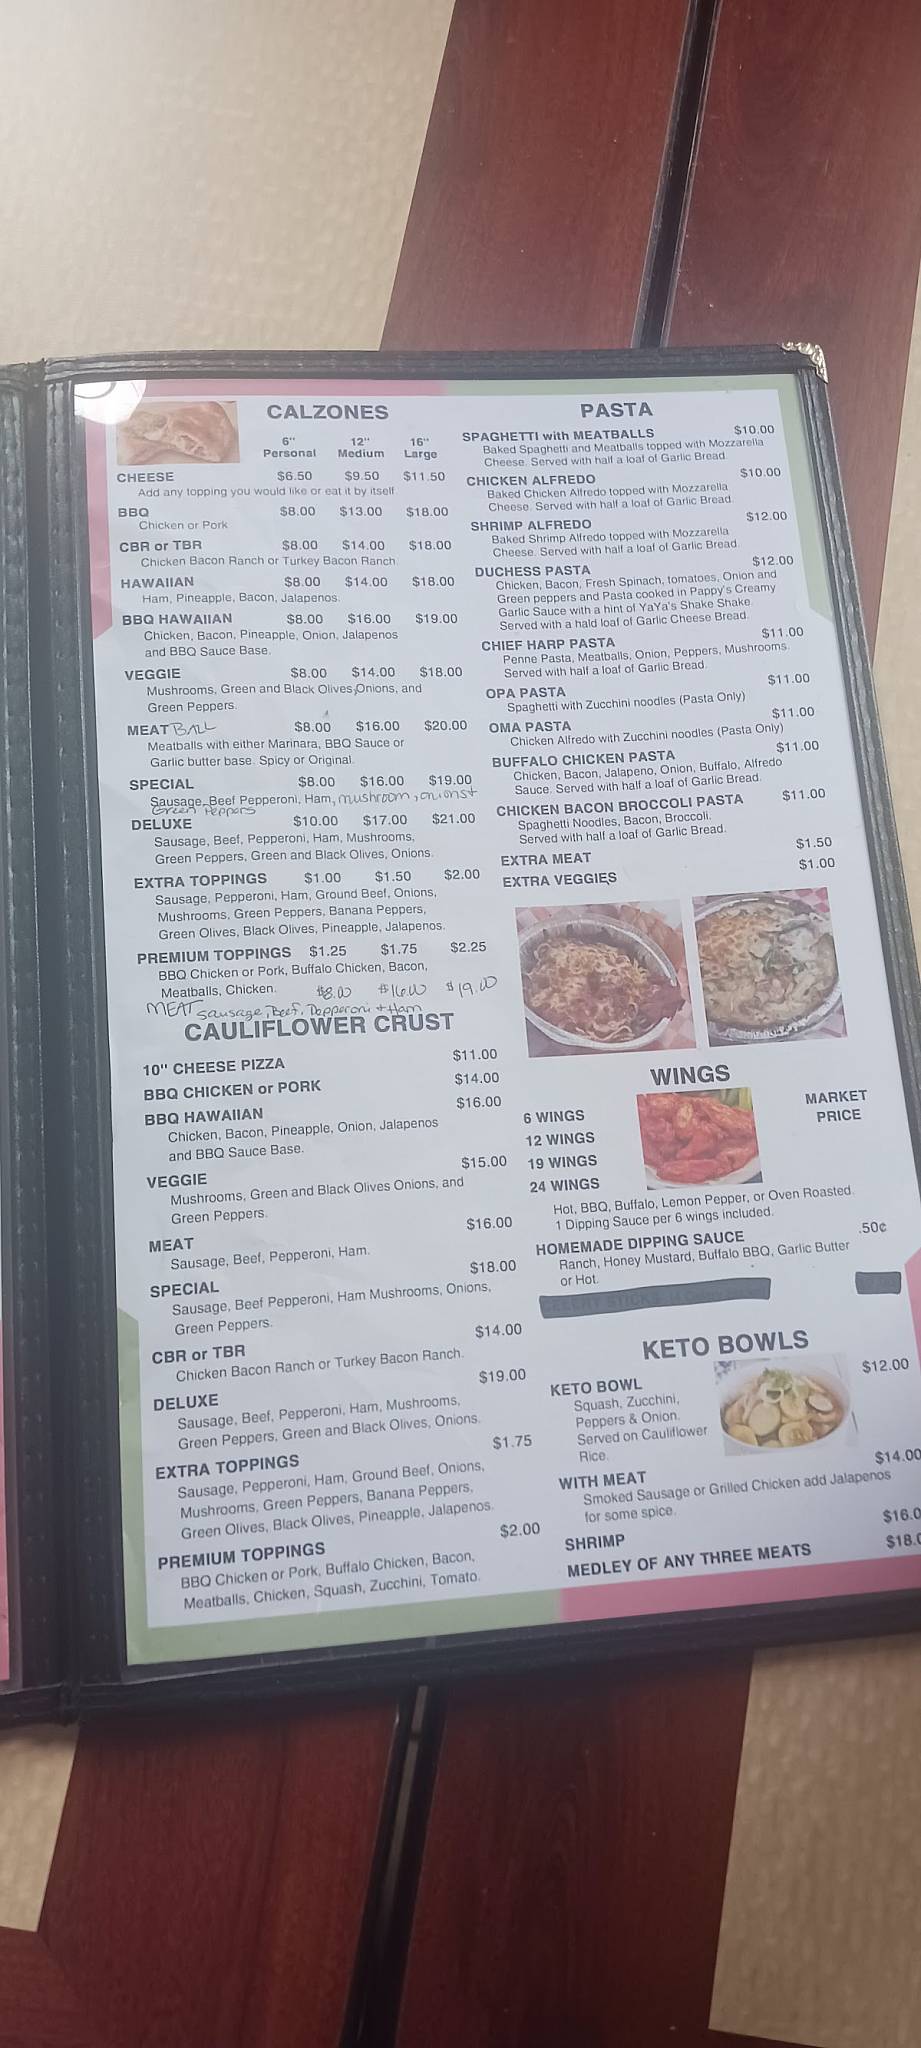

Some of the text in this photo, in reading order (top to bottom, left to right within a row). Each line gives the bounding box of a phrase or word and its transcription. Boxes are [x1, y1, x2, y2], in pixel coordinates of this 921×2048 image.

[266, 404, 388, 420] CALZONES
[580, 401, 653, 418] PASTA
[462, 428, 654, 442] SPAGHETTI with MEATBALLS
[734, 424, 774, 435] $10.00
[263, 448, 437, 460] Personal Medium Large
[116, 470, 445, 483] CHEESE $6.50 $9.50 $11.50
[466, 473, 595, 486] CHICKEN ALFREDO
[740, 467, 780, 478] $10.00
[117, 505, 448, 518] BBQ $8.00 $13.00 $18.00
[138, 520, 227, 530] Chicken or Pork
[119, 539, 452, 552] CBR or TBR $8.00 $14.00 $18.00
[752, 555, 793, 567] $12.00
[475, 564, 591, 577] DUCHESS PASTA
[495, 569, 777, 591] Chicken, Bacon, Fresh Spinach, tomatoes, Onion and
[767, 672, 810, 686] $11.00
[486, 686, 566, 699] OPA PASTA
[147, 701, 237, 713] Green Peppers.
[507, 690, 745, 714] Spaghetti with Zucchini noodles (Pasta Only)
[127, 719, 467, 736] MEAT $8.00 $16.00 $20.00
[776, 740, 819, 754] $11.00
[492, 749, 675, 767] BUFFALO CHICKEN PASTA
[129, 774, 472, 790] SPECIAL $8.00 $16.00 $19.00
[782, 788, 825, 801] $11.00
[496, 793, 743, 816] CHICKEN BACON BROCCOLI PASTA
[154, 831, 415, 849] Sausage, Beef, Pepperoni, Ham, Mushrooms,
[796, 836, 832, 850] $1.50
[500, 851, 591, 866] EXTRA MEAT
[137, 941, 486, 964] PREMIUM TOPPINGS $1.25 $1.75 $2.25
[161, 983, 276, 998] Meatballs, Chicken.
[184, 1009, 454, 1041] CAULIFLOWER CRUST
[452, 1048, 497, 1062] $11.00
[172, 1060, 236, 1075] CHEESE
[240, 1057, 285, 1071] PIZZA
[454, 1071, 499, 1086] $14.00
[649, 1064, 730, 1086] WINGS
[143, 1079, 321, 1101] BBQ CHICKEN or PORK
[805, 1089, 867, 1104] MARKET
[456, 1095, 501, 1109] $16.00
[144, 1107, 263, 1126] BBQ HAWAIIAN
[523, 1109, 584, 1124] 6 WINGS
[816, 1108, 861, 1122] PRICE
[529, 1177, 600, 1193] 24 WINGS
[466, 1216, 512, 1231] $16.00
[556, 1206, 774, 1232] 1 Dipping Sauce per 6 wings included.
[149, 1237, 194, 1253] MEAT
[535, 1230, 744, 1255] HOMEMADE DIPPING SAUCE
[170, 1246, 369, 1270] Sausage, Beef, Pepperoni, Ham.
[475, 1322, 522, 1339] $14.00
[642, 1329, 808, 1360] KETO BOWLS
[151, 1344, 245, 1364] CBR or TBR
[862, 1357, 909, 1374] $12.00
[550, 1377, 642, 1396] KETO BOWL
[577, 1425, 707, 1446] Served on Cauliflower
[579, 1450, 608, 1464] Rice.
[874, 1447, 921, 1465] $14.00
[558, 1470, 646, 1490] WITH MEAT
[500, 1521, 540, 1538] $2.00
[565, 1533, 624, 1551] SHRIMP
[158, 1541, 325, 1570] PREMIUM TOPPINGS
[567, 1542, 811, 1577] MEDLEY OF ANY THREE MEATS
